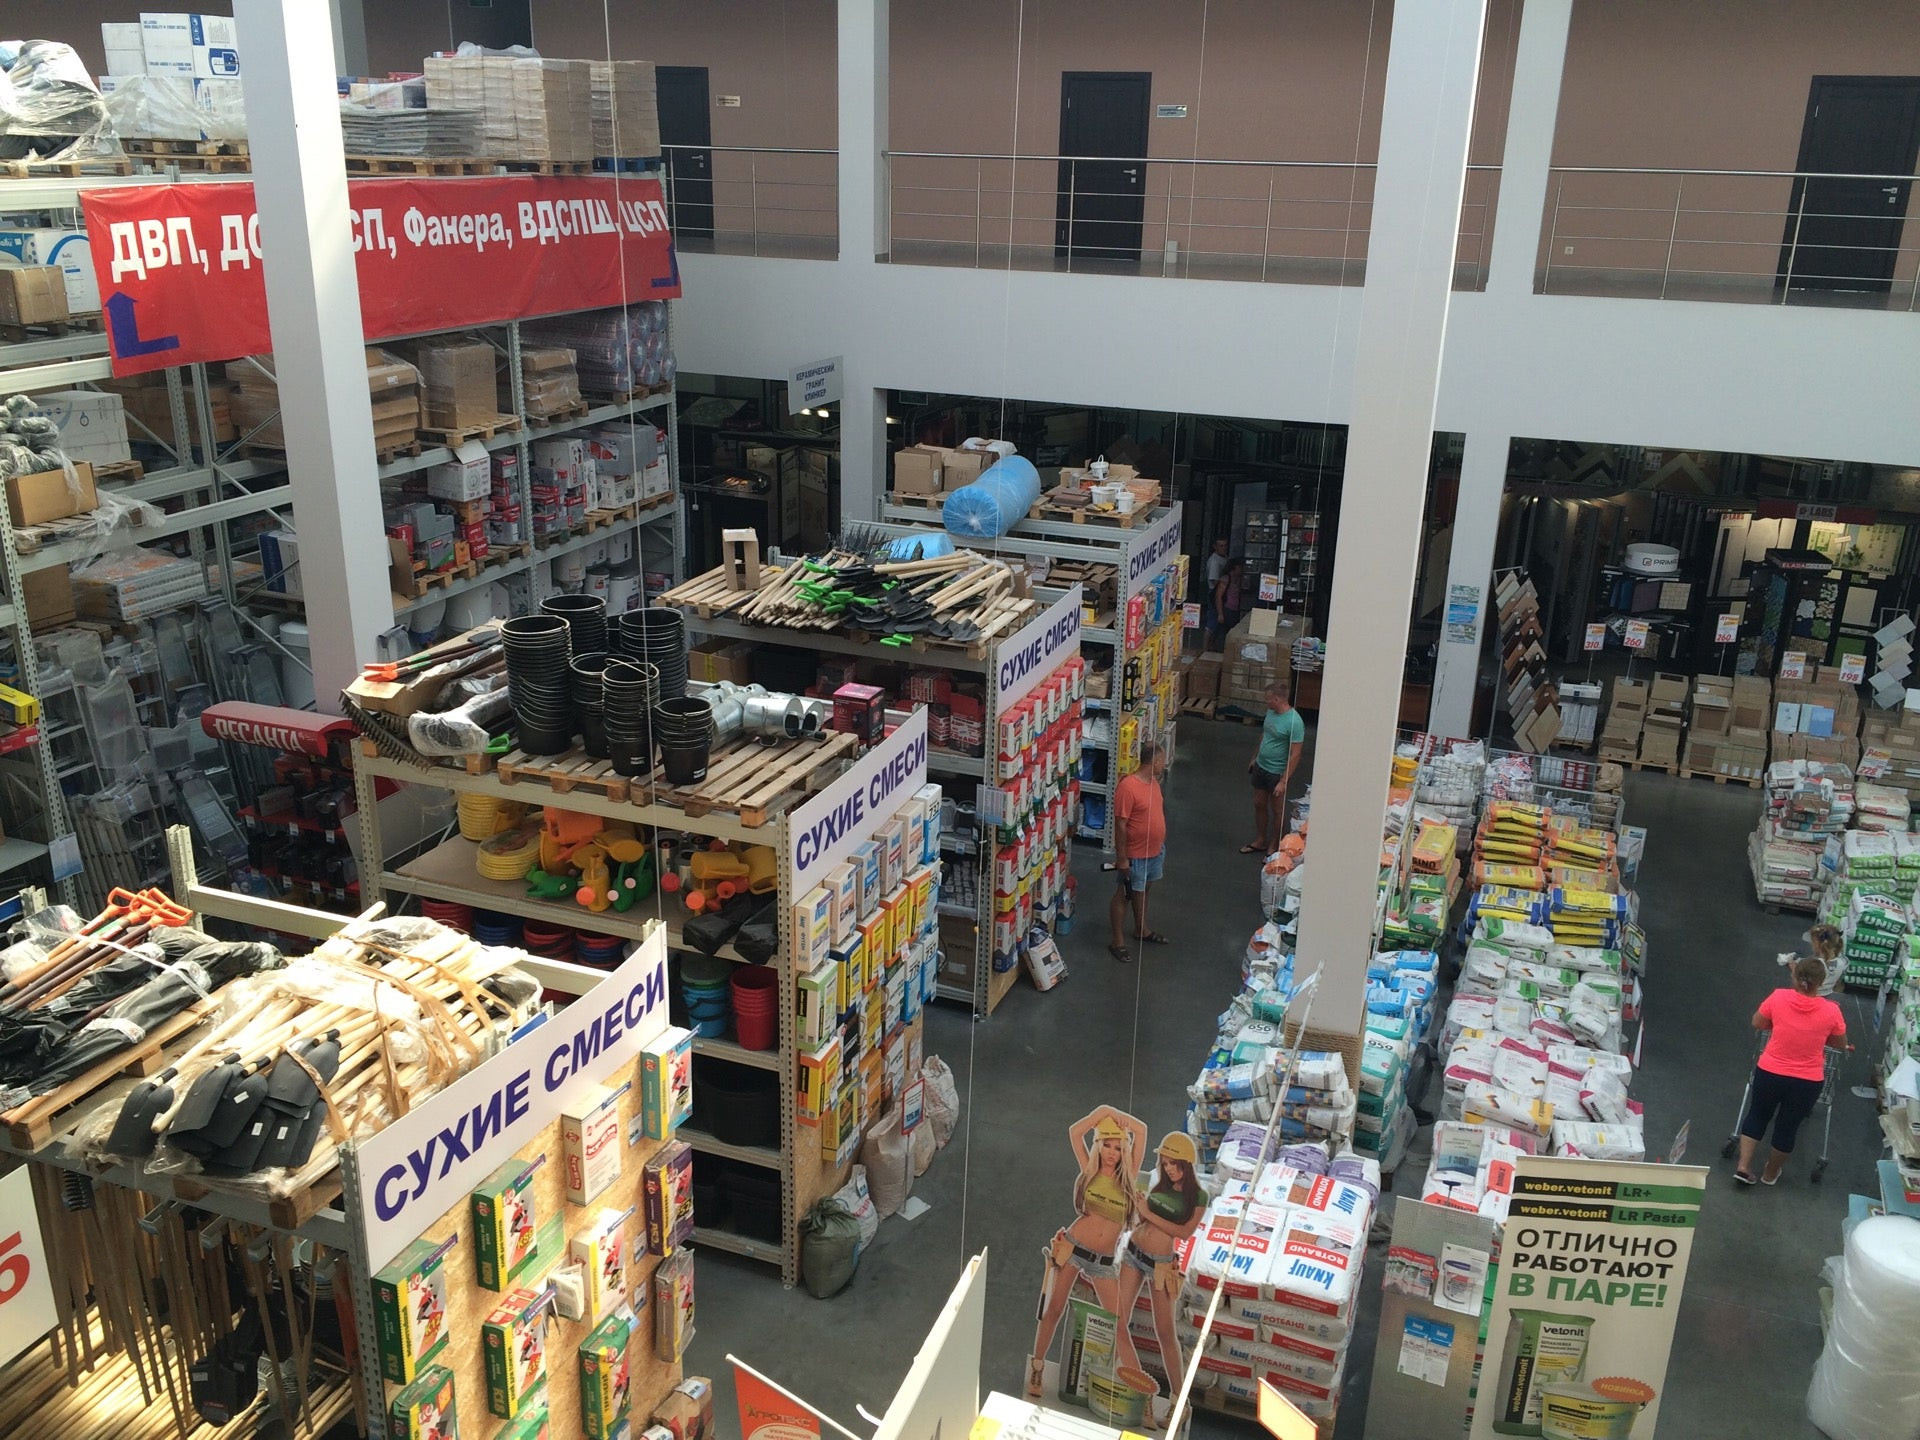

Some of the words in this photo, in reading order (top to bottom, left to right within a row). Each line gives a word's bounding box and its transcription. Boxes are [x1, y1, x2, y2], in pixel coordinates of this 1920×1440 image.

[110, 216, 209, 284] ДВП,
[403, 206, 513, 253] Фанера,
[620, 200, 670, 239] ЦСП
[1130, 540, 1157, 580] СУХИЕ
[1158, 520, 1180, 558] СМЕСИ
[1000, 637, 1042, 691] СУХИЕ
[1045, 604, 1081, 656] СМЕСИ
[213, 718, 307, 753] РЕСАНТА
[796, 786, 864, 871] СУХИЕ
[869, 731, 926, 809] СМЕСИ
[1864, 915, 1901, 932] UNIS
[1857, 933, 1896, 948] UNIS
[1848, 948, 1887, 962] UNIS
[1846, 965, 1885, 976] UNIS
[1368, 1039, 1393, 1051] 959
[374, 1069, 530, 1222] СУХИЕ
[544, 960, 664, 1093] СМЕСИ
[1525, 1182, 1612, 1196] weber.vetonit
[1622, 1187, 1652, 1198] LR+
[1520, 1204, 1608, 1219] weber.vetonit
[1618, 1210, 1639, 1222] LR
[1642, 1211, 1686, 1224] Pasta
[1517, 1229, 1677, 1258] ОТЛИЧНО
[1289, 1244, 1344, 1265] ROTBAND
[1288, 1259, 1335, 1290] KNAUF
[1513, 1253, 1673, 1279] РАБОТАЮТ
[1508, 1273, 1535, 1297] В
[1547, 1276, 1668, 1308] ПАРЕ!
[1263, 1314, 1305, 1330] РОТБАНД
[1543, 1325, 1584, 1337] vetonit
[1251, 1355, 1292, 1372] РОТБАНД
[1600, 1382, 1645, 1397] НОВИНКА
